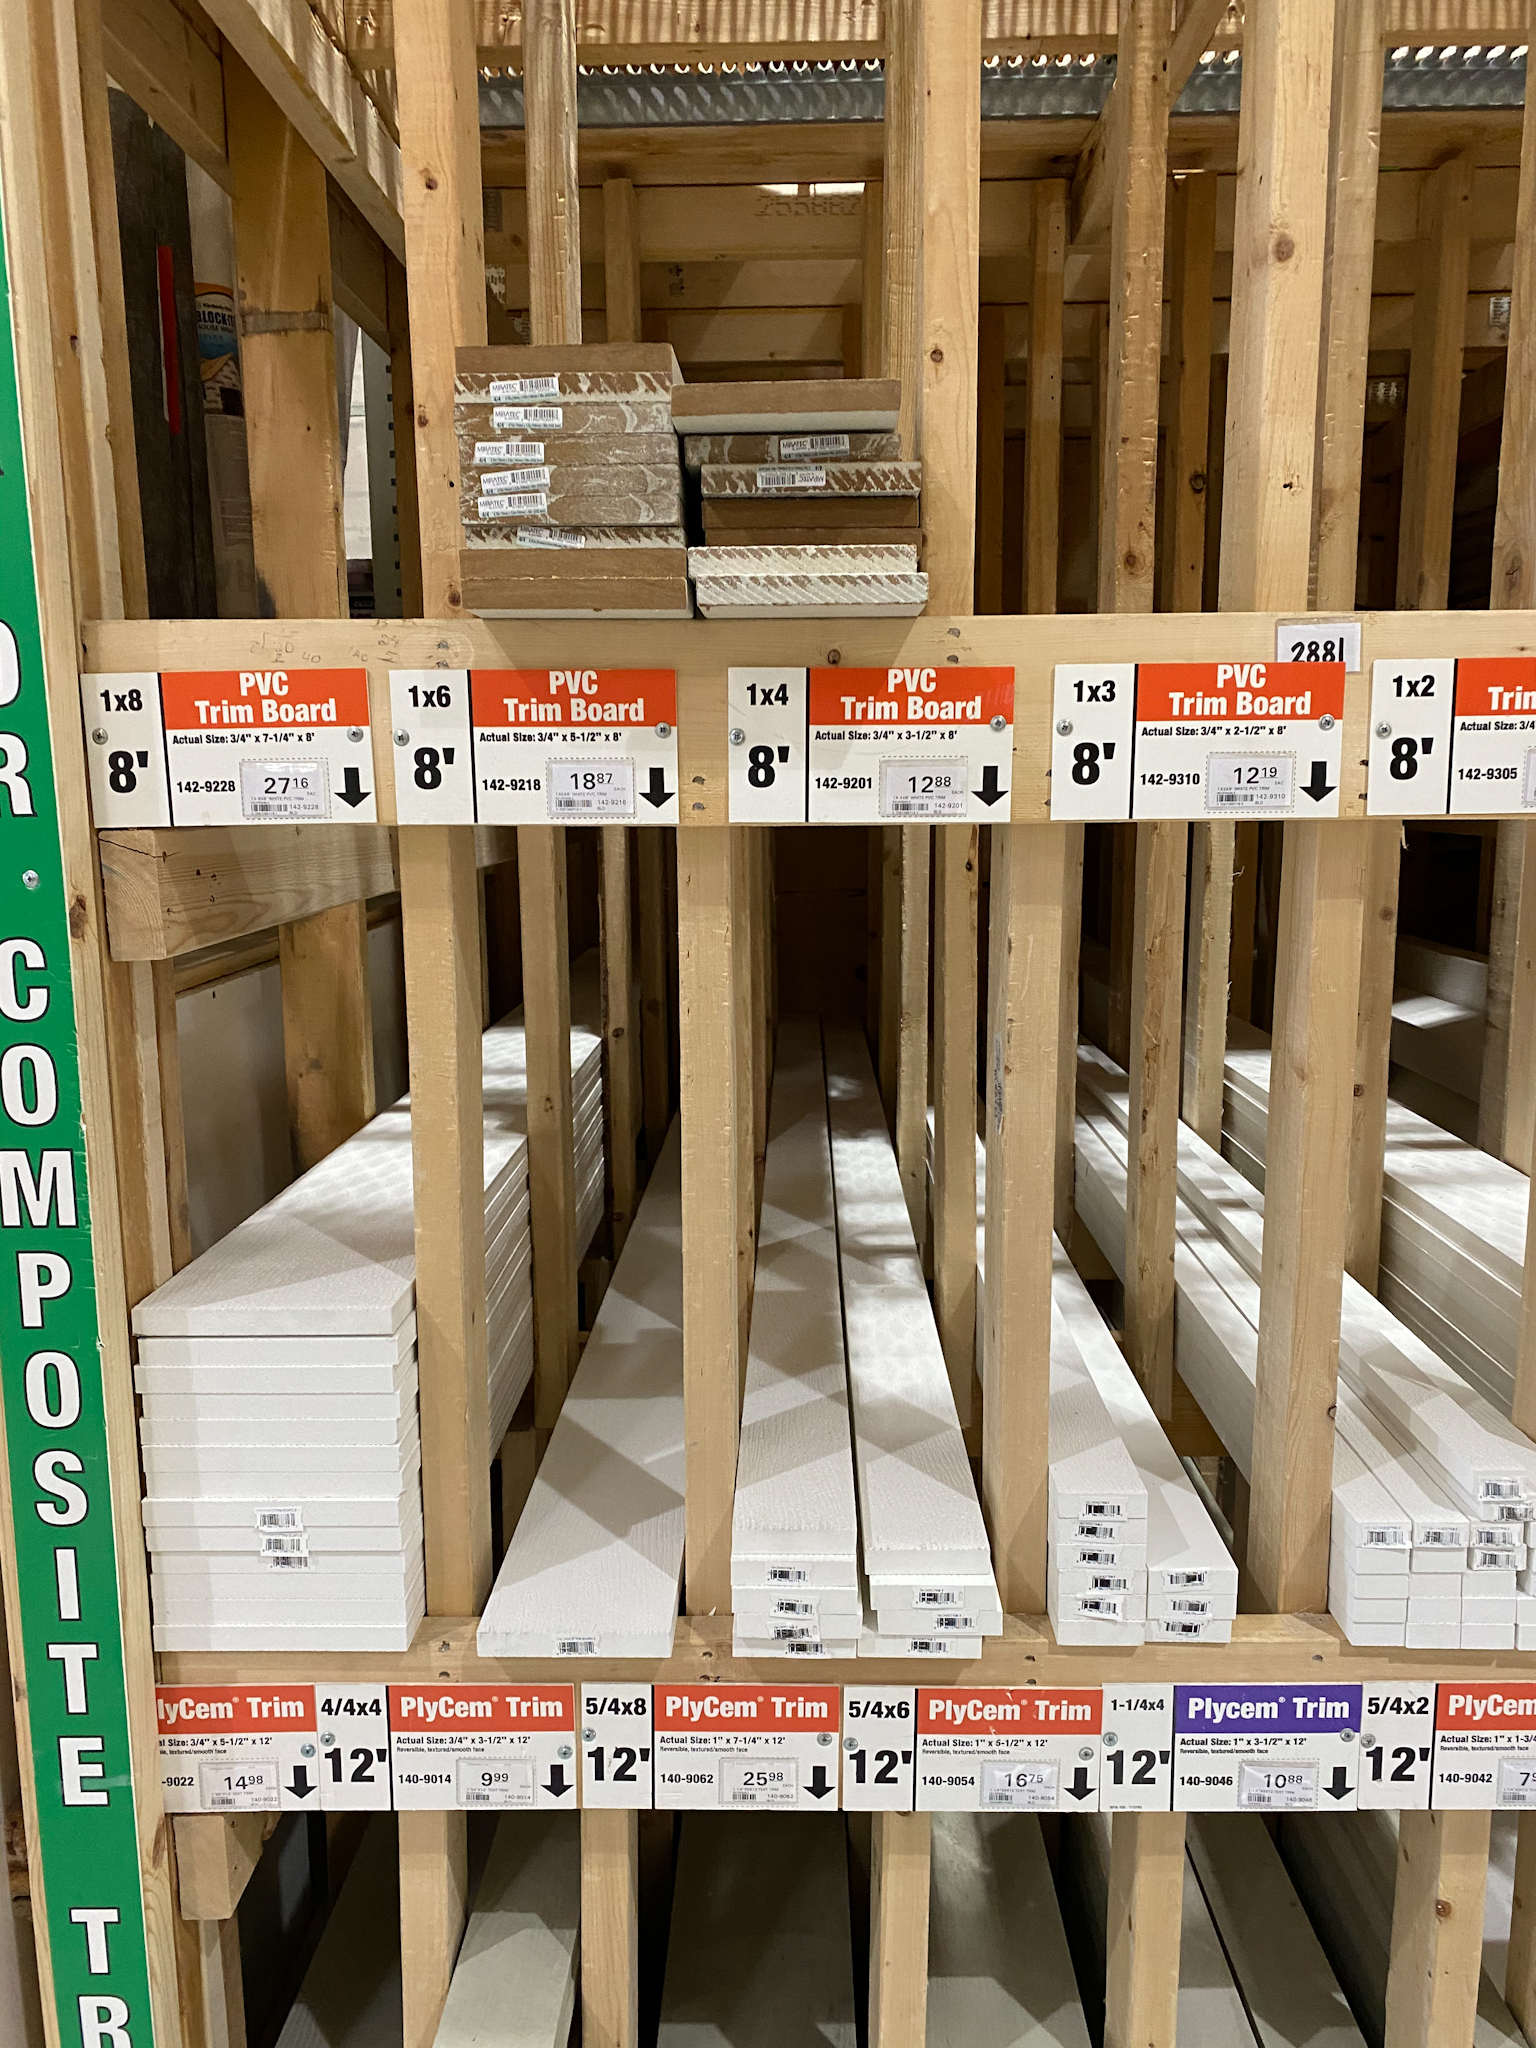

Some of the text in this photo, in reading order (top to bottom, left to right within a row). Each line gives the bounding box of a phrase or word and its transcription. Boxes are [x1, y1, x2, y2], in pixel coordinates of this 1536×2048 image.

[238, 670, 288, 696] PVC
[549, 670, 598, 694] PVC
[888, 668, 936, 692] PVC
[1217, 664, 1266, 688] PVC
[1393, 675, 1434, 697] 1x2
[100, 689, 142, 711] 1x8
[409, 685, 451, 707] 1x6
[747, 684, 788, 705] 1x4
[1074, 680, 1115, 702] 1x3
[195, 698, 336, 724] Trim Board
[503, 698, 644, 721] Trim Board
[841, 696, 981, 719] Trim Board
[1169, 691, 1311, 715] Trim Board
[815, 731, 845, 740] Actual
[849, 731, 870, 740] Size:
[873, 731, 894, 739] 3/4"
[906, 731, 937, 739] 3-1/2"
[949, 731, 957, 739] 8'
[1142, 727, 1172, 736] Actual
[1176, 727, 1198, 735] Size:
[1201, 727, 1222, 735] 3/4"
[1234, 726, 1265, 735] 2-1/2"
[1277, 726, 1286, 734] 8'
[1460, 722, 1491, 730] Actual
[1495, 721, 1517, 730] Size:
[173, 735, 202, 744] Actual
[206, 735, 228, 743] Size:
[231, 734, 251, 743] 3/4"
[263, 733, 294, 742] 7-1/4"
[306, 733, 314, 741] 8'
[480, 733, 509, 741] Actual
[513, 733, 535, 741] Size:
[538, 733, 558, 741] 3/4"
[571, 732, 601, 741] 5-1/2"
[613, 732, 621, 741] 8'
[414, 747, 454, 789] 8'
[748, 746, 789, 788] 8'
[1072, 743, 1115, 785] 8'
[1390, 737, 1433, 780] 8'
[109, 751, 148, 793] 8'
[1141, 774, 1200, 785] 142-9310
[1459, 768, 1517, 780] 142-9305
[177, 781, 235, 792] 142-9228
[483, 779, 540, 790] 142-9218
[816, 778, 871, 789] 142-9201
[246, 1697, 304, 1718] Trim
[321, 1698, 381, 1715] 4/4x4
[506, 1697, 562, 1717] Trim
[586, 1698, 646, 1715] 5/4x8
[771, 1697, 827, 1718] Trim
[849, 1701, 909, 1718] 5/4x6
[1034, 1700, 1091, 1720] Trim
[1112, 1699, 1164, 1710] 1-1/4x4
[1293, 1697, 1349, 1718] Trim
[1368, 1697, 1429, 1714] 5/4x2
[325, 1748, 387, 1782] 12'
[588, 1747, 650, 1781] 12'
[849, 1749, 912, 1783] 12'
[1107, 1750, 1170, 1784] 12'
[1365, 1746, 1431, 1782] 12'
[162, 1777, 194, 1786] -9022
[399, 1775, 451, 1783] 140-9014
[661, 1774, 713, 1783] 140-9062
[923, 1776, 974, 1785] 140-9054
[1180, 1777, 1233, 1785] 140-9046
[1439, 1774, 1492, 1782] 140-9042
